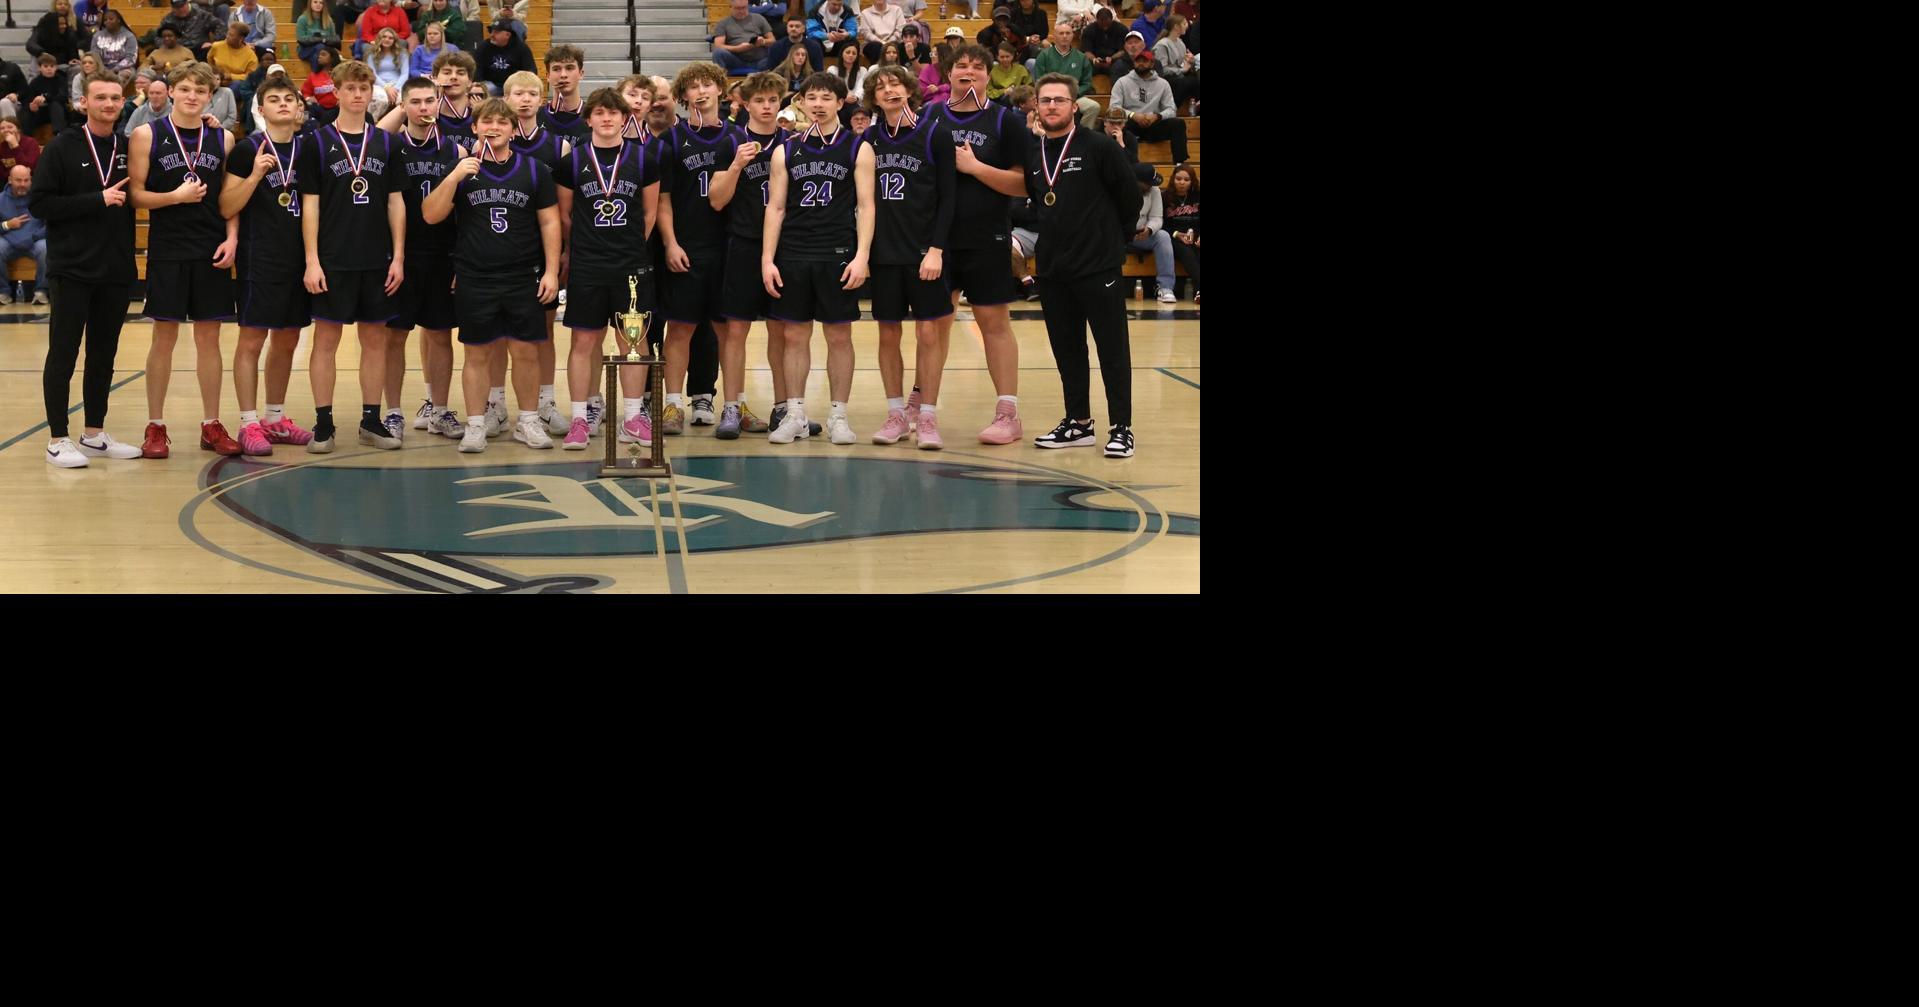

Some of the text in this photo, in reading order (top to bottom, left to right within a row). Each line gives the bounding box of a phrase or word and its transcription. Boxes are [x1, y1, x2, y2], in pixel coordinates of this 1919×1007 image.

[158, 151, 221, 171] WILCATS
[330, 157, 385, 177] WILATS
[790, 161, 849, 180] WILDCATS
[875, 153, 922, 172] ILDCATS
[352, 176, 369, 204] 2
[580, 180, 638, 198] WILATS
[800, 181, 833, 207] 24
[880, 172, 905, 200] 12
[467, 188, 530, 208] WILDCATS
[490, 207, 508, 233] 5
[593, 199, 627, 227] 22
